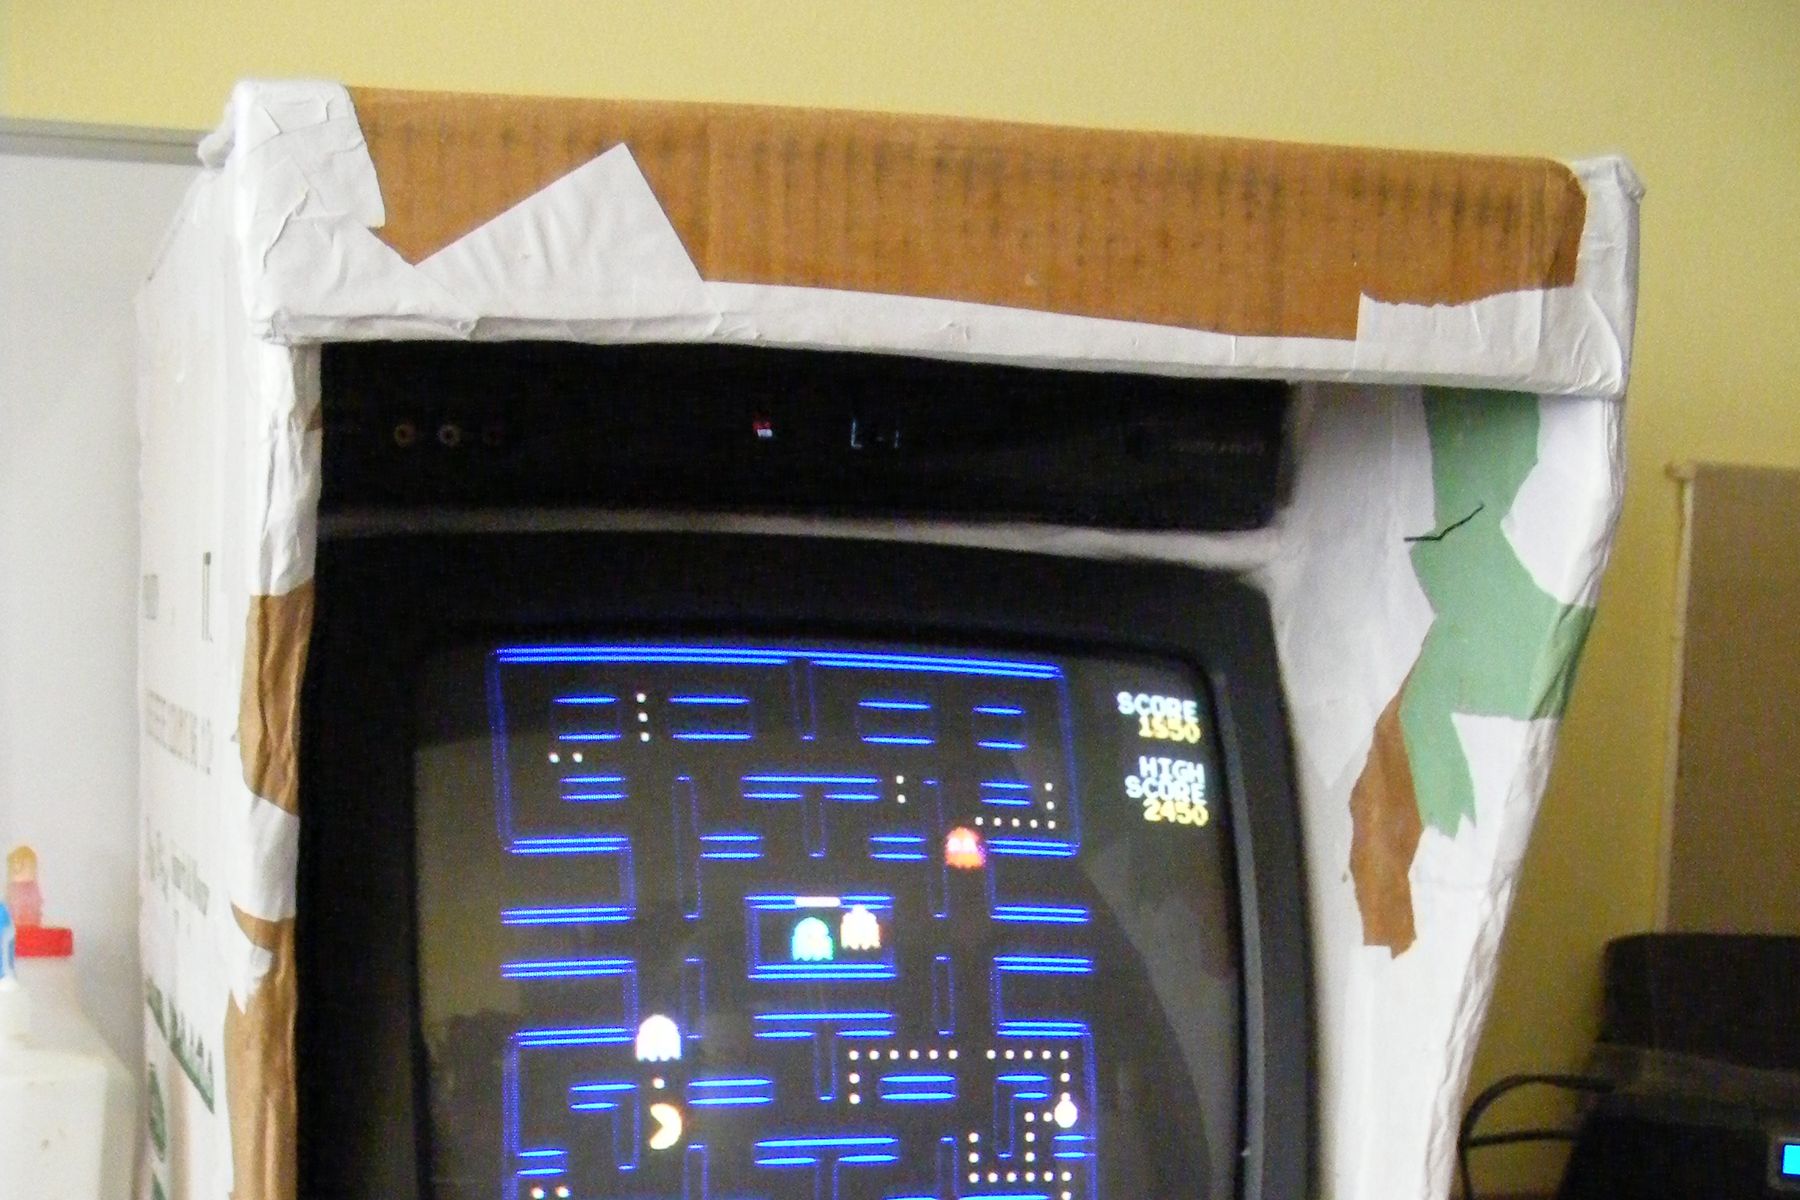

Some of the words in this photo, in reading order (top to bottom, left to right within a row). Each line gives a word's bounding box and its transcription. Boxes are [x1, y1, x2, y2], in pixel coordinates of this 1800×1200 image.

[1117, 691, 1198, 723] SCORE
[1139, 755, 1205, 784] HIGH
[1125, 775, 1206, 806] SCORE
[1143, 798, 1209, 826] 2450
